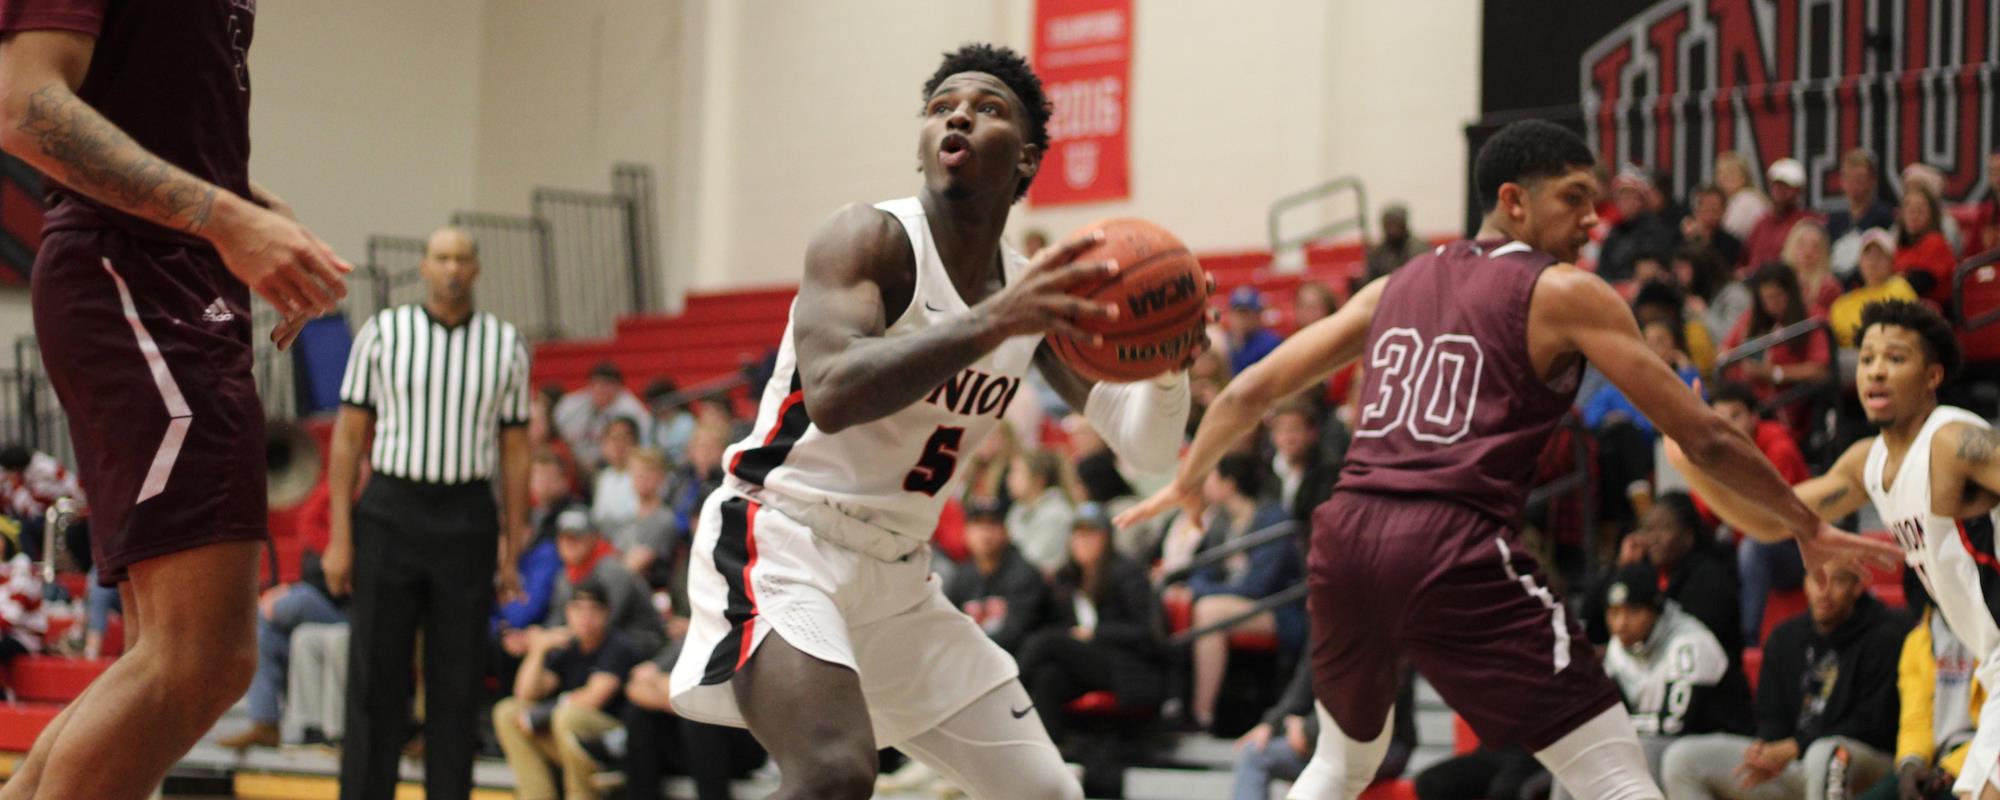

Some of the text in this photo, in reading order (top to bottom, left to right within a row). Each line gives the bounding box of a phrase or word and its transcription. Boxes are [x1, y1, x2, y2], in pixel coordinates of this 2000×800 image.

[1128, 271, 1196, 319] NCAA
[1356, 327, 1484, 444] 30
[903, 424, 965, 498] 5
